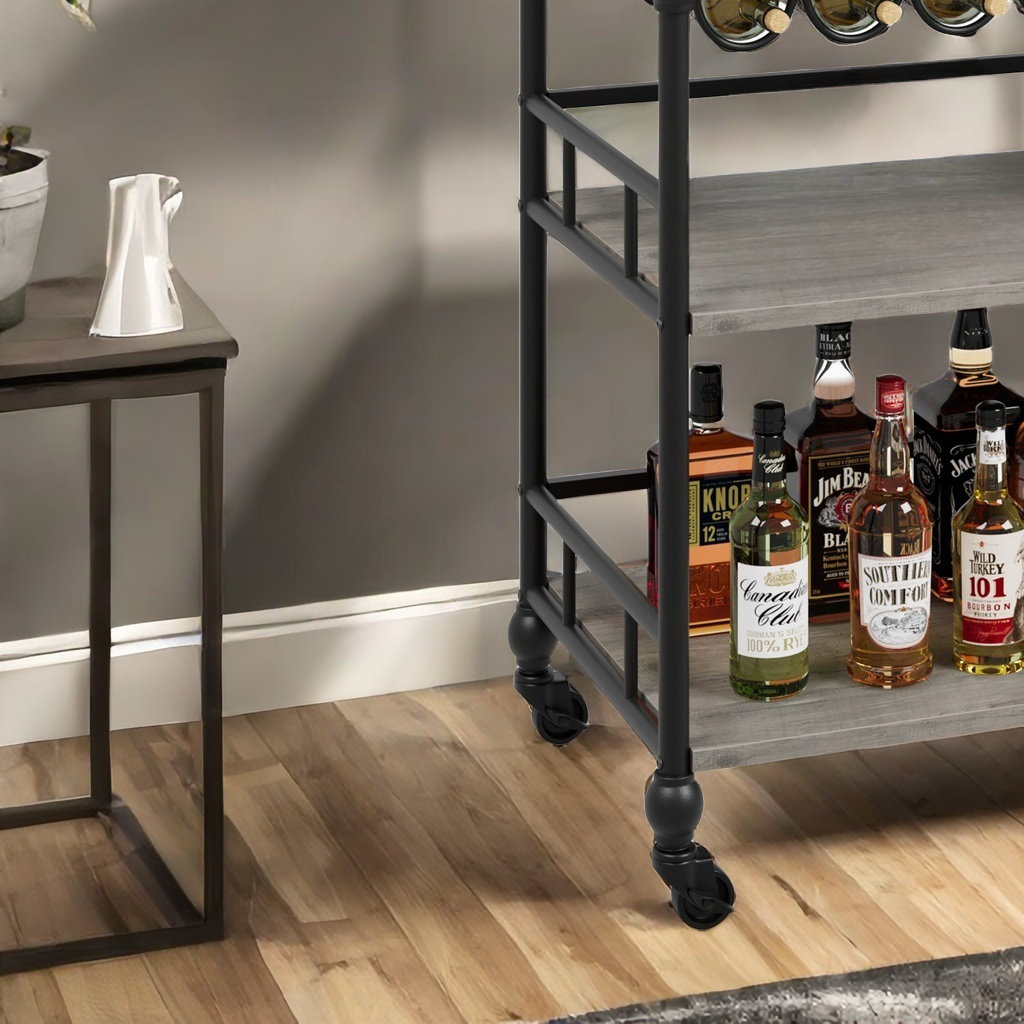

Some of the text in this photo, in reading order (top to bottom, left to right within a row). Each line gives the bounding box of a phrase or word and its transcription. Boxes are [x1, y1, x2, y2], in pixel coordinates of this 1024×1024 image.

[813, 466, 870, 508] JIM BEA
[702, 525, 716, 543] 12
[823, 532, 849, 549] BLA
[973, 550, 996, 564] WILD
[969, 559, 1005, 576] TURKEY
[869, 581, 929, 606] COMFORT
[969, 577, 1007, 598] 101
[967, 602, 1011, 612] BOURBON
[747, 637, 780, 653] 100%
